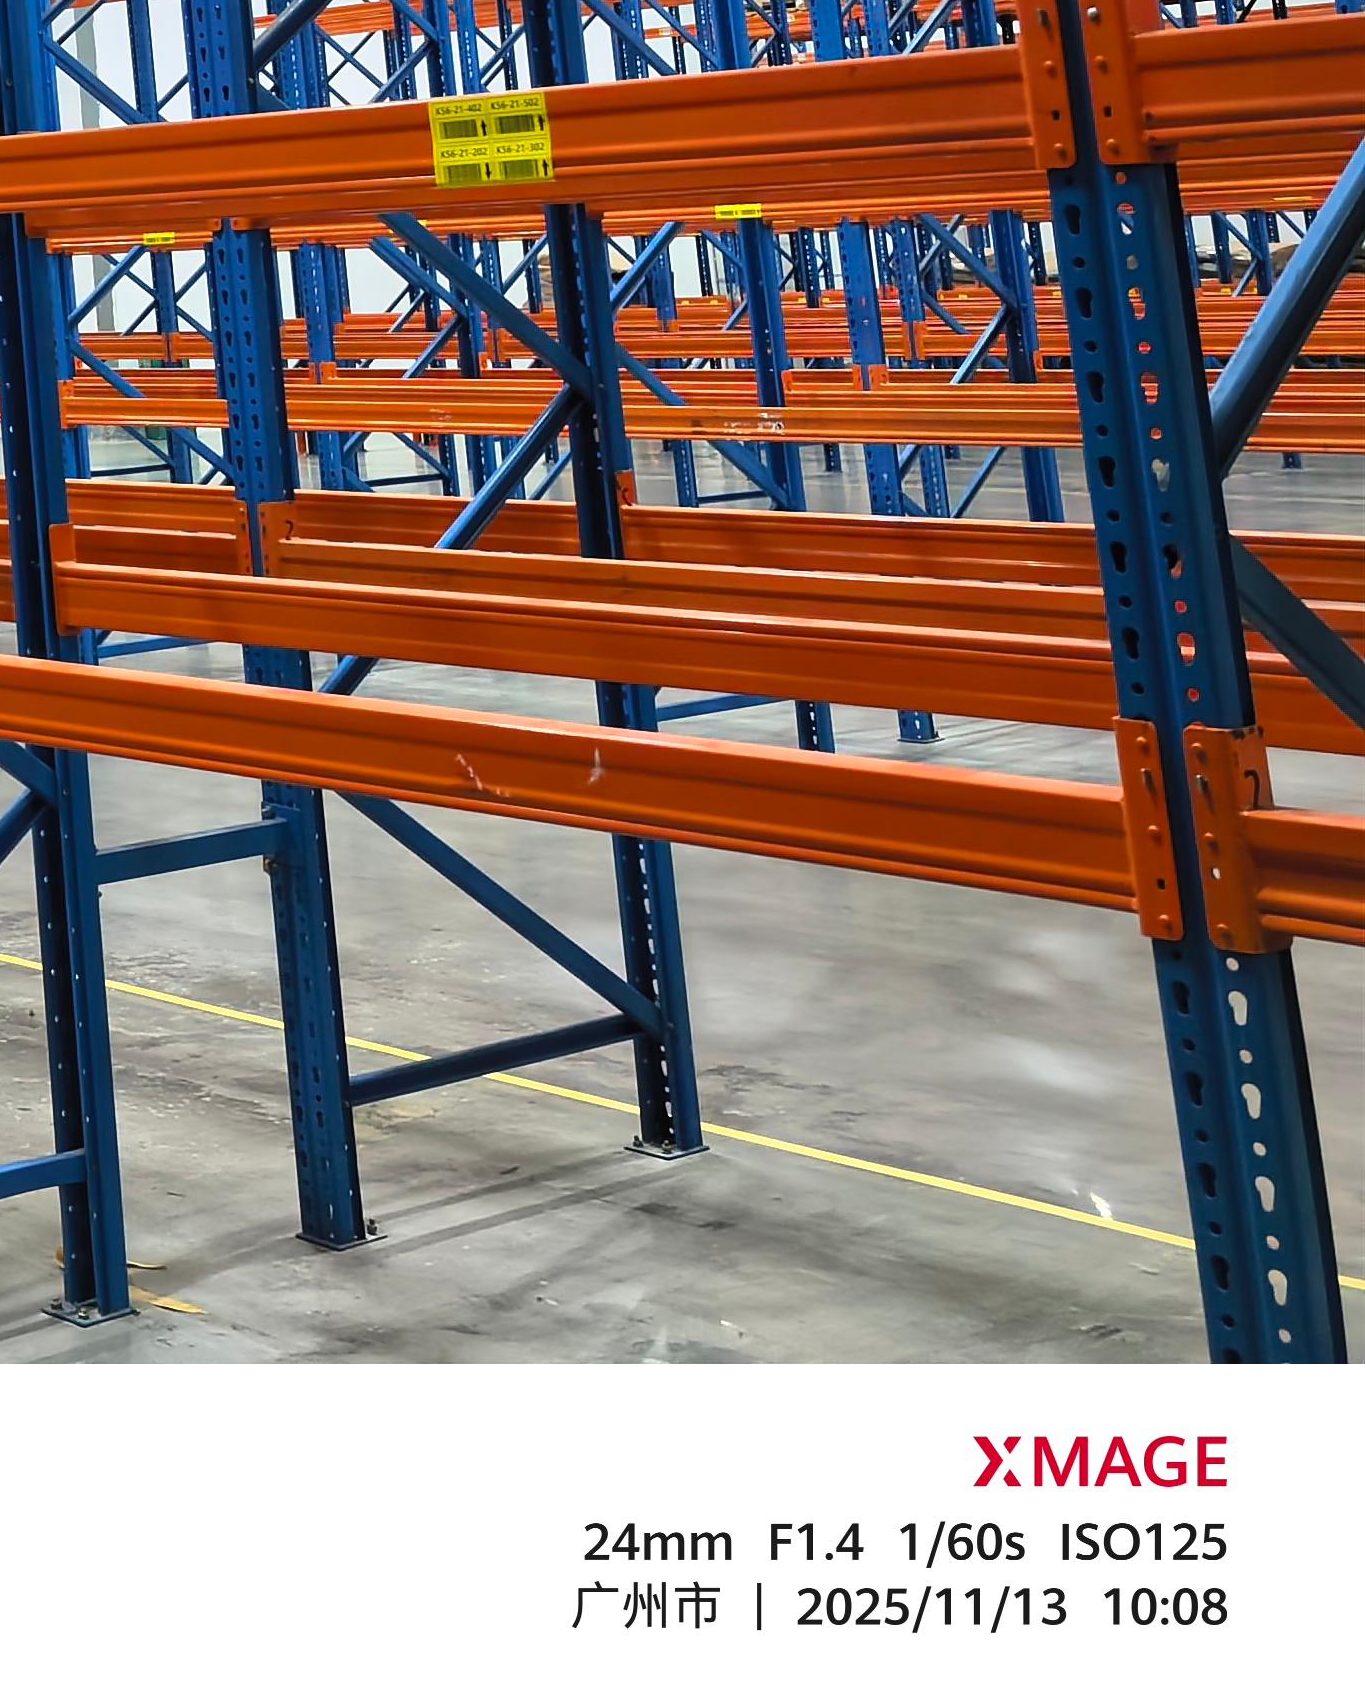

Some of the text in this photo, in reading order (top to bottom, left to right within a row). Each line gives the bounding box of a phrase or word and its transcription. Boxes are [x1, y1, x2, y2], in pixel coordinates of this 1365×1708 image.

[436, 103, 482, 116] K56-21-402
[490, 98, 540, 110] K56-21-502
[441, 147, 488, 159] K56-21-202
[496, 142, 546, 154] K56-21-302
